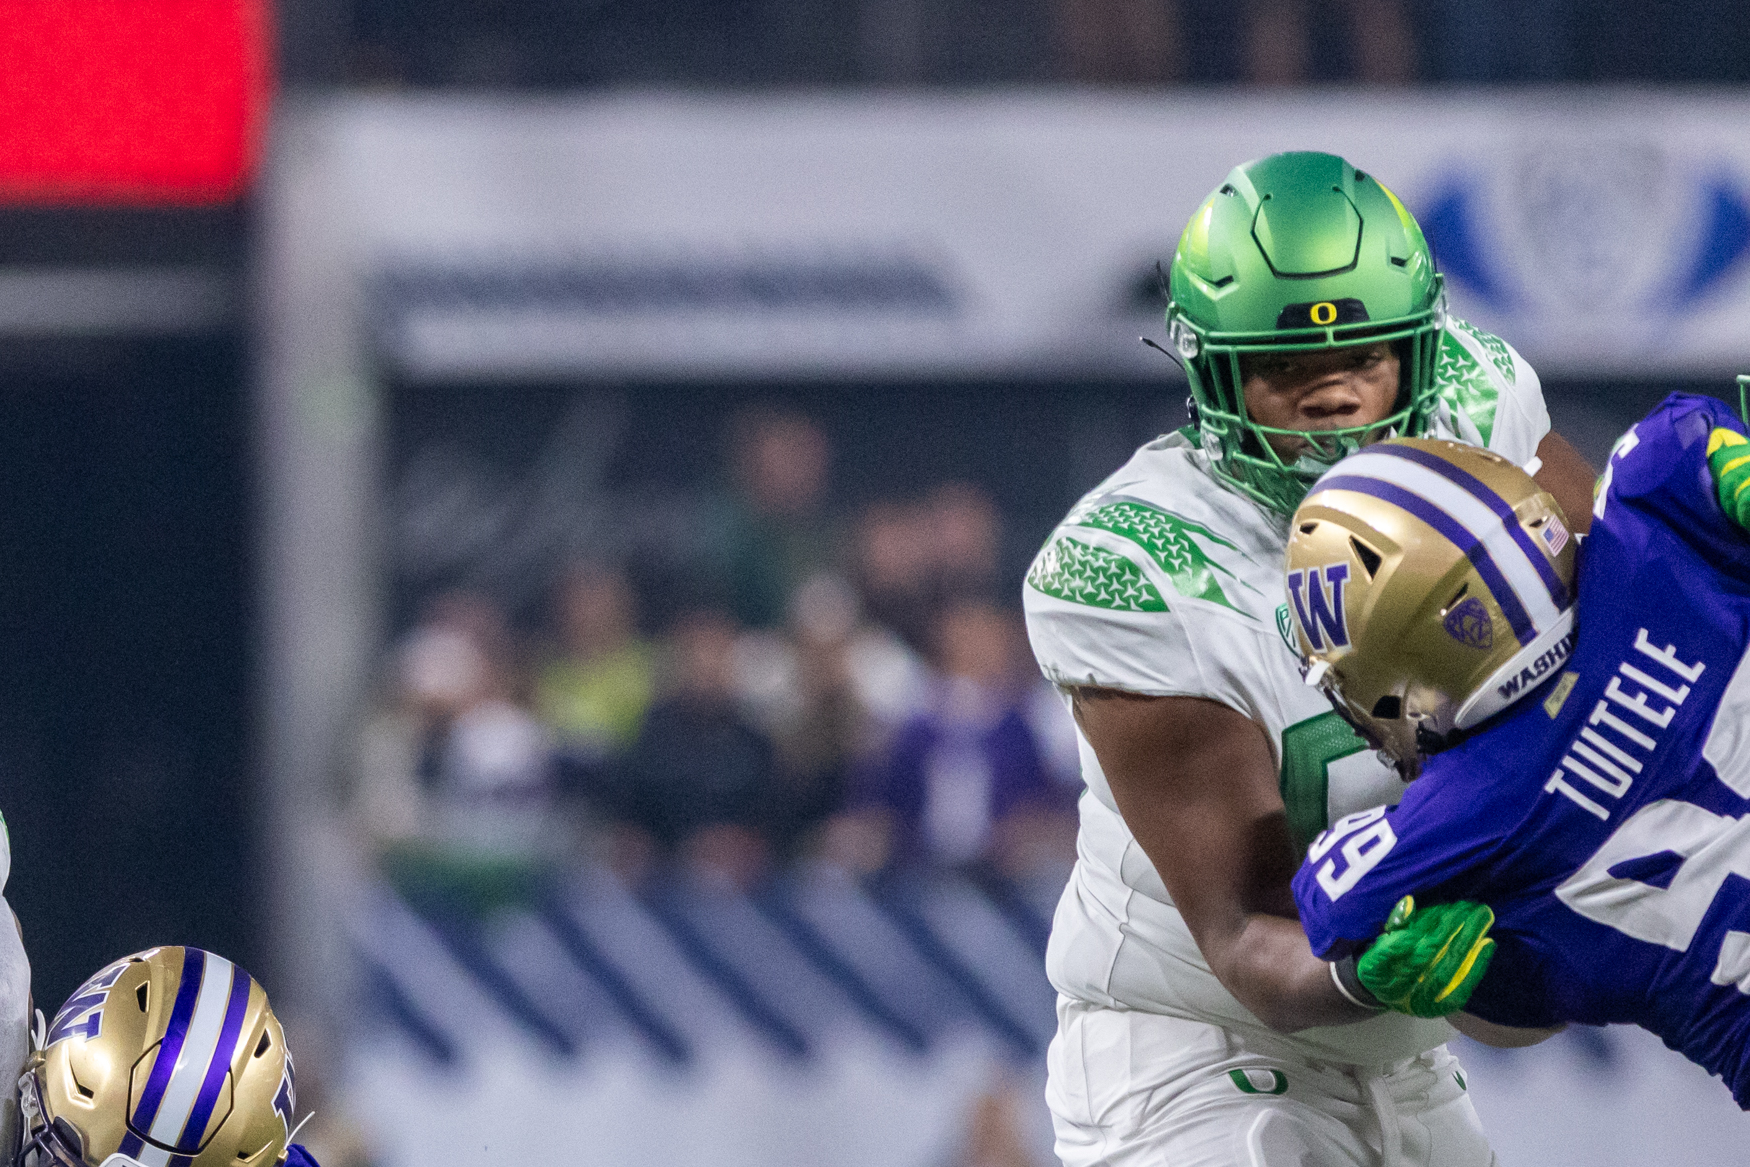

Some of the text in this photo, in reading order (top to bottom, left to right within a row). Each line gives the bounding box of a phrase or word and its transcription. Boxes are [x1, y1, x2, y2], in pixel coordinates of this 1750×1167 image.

[1310, 302, 1338, 325] O
[1287, 563, 1351, 652] W
[1498, 634, 1574, 699] WASHI
[1544, 627, 1706, 822] TUITELE
[1308, 804, 1398, 903] 99
